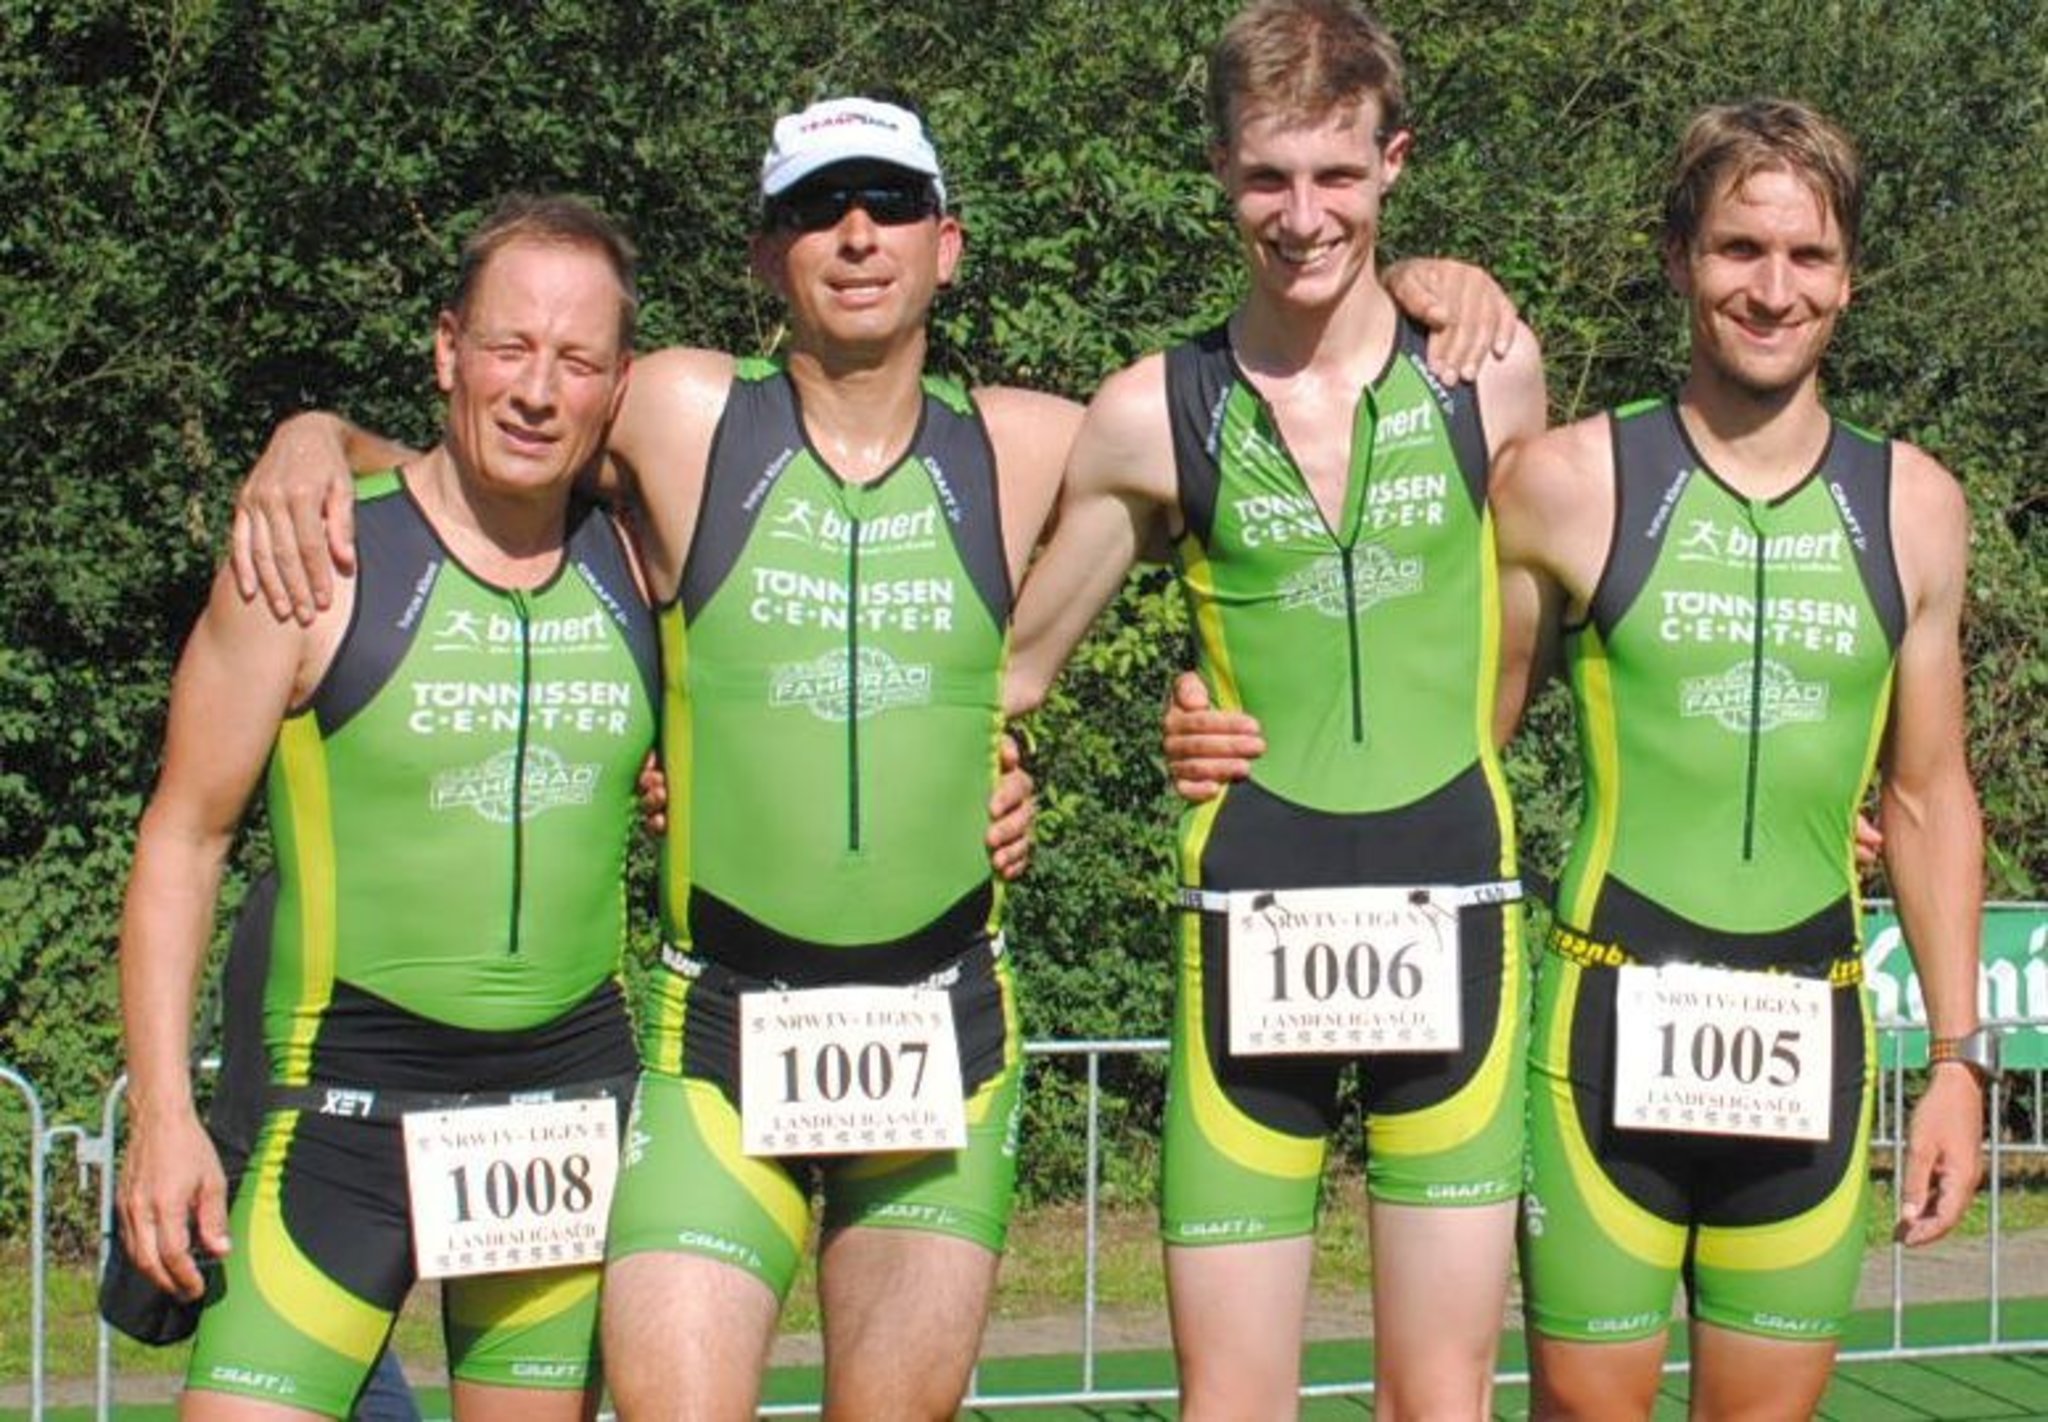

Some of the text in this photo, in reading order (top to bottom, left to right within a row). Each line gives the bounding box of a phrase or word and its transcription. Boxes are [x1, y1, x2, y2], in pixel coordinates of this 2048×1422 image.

[1269, 941, 1424, 1002] 1006
[779, 1041, 929, 1103] 1007
[1658, 1022, 1801, 1087] 1005
[449, 1154, 593, 1223] 1008
